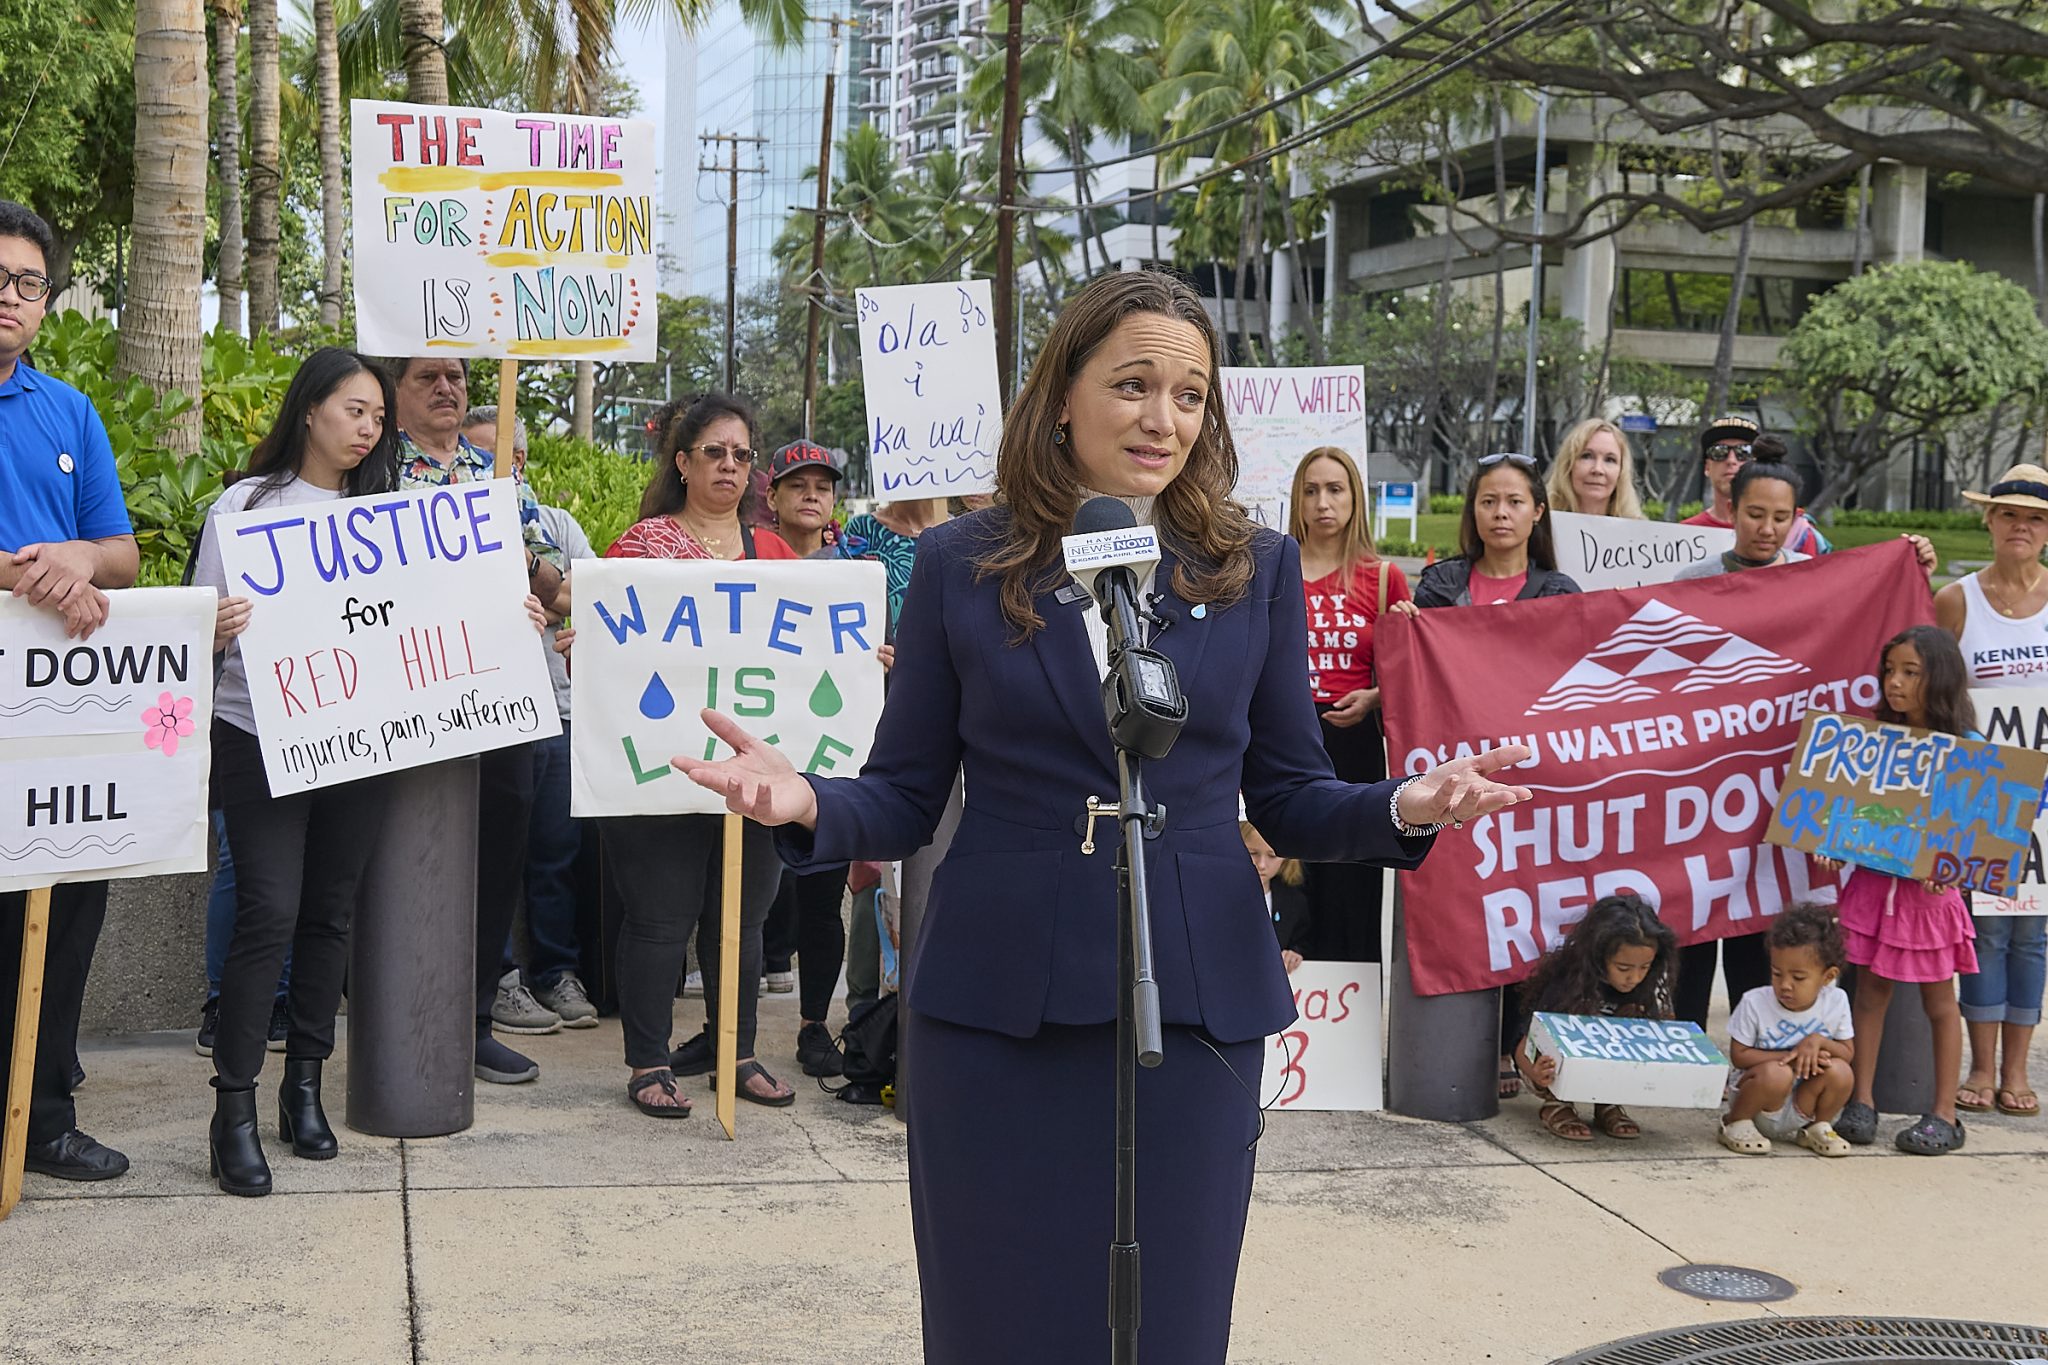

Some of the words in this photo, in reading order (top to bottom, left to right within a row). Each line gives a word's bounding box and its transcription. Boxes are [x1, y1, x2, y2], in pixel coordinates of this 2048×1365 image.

[377, 114, 484, 166] THE
[516, 119, 623, 170] TIME
[384, 197, 472, 247] FOR
[498, 188, 651, 255] ACTION
[424, 278, 470, 339] IS
[513, 266, 622, 340] NOW
[1226, 377, 1282, 415] NAVY
[1292, 375, 1361, 414] WATER
[930, 403, 985, 448] wai
[236, 489, 503, 595] JUSTICE
[1071, 543, 1112, 555] NEWS
[1116, 537, 1150, 550] NOW
[1086, 534, 1132, 544] HAWAII
[1581, 529, 1707, 574] Decisions
[341, 597, 394, 634] for
[593, 582, 871, 655] WATER
[26, 644, 188, 687] DOWN
[274, 648, 358, 717] RED
[399, 620, 500, 690] HILL
[706, 666, 776, 717] IS
[2007, 662, 2043, 675] 2024
[279, 726, 377, 784] injuries,
[381, 710, 435, 762] pain,
[437, 689, 539, 732] suffering
[1547, 715, 1688, 764] WATER
[1799, 714, 1956, 797] PROTECT
[27, 782, 127, 826] HILL
[1779, 786, 1827, 845] OR
[1930, 771, 2039, 847] WAI
[1472, 794, 1645, 880] SHUT
[1483, 869, 1661, 971] RED
[1684, 843, 1855, 931] HIL
[1550, 1014, 1691, 1042] Mahalo
[1276, 1031, 1309, 1106] 3
